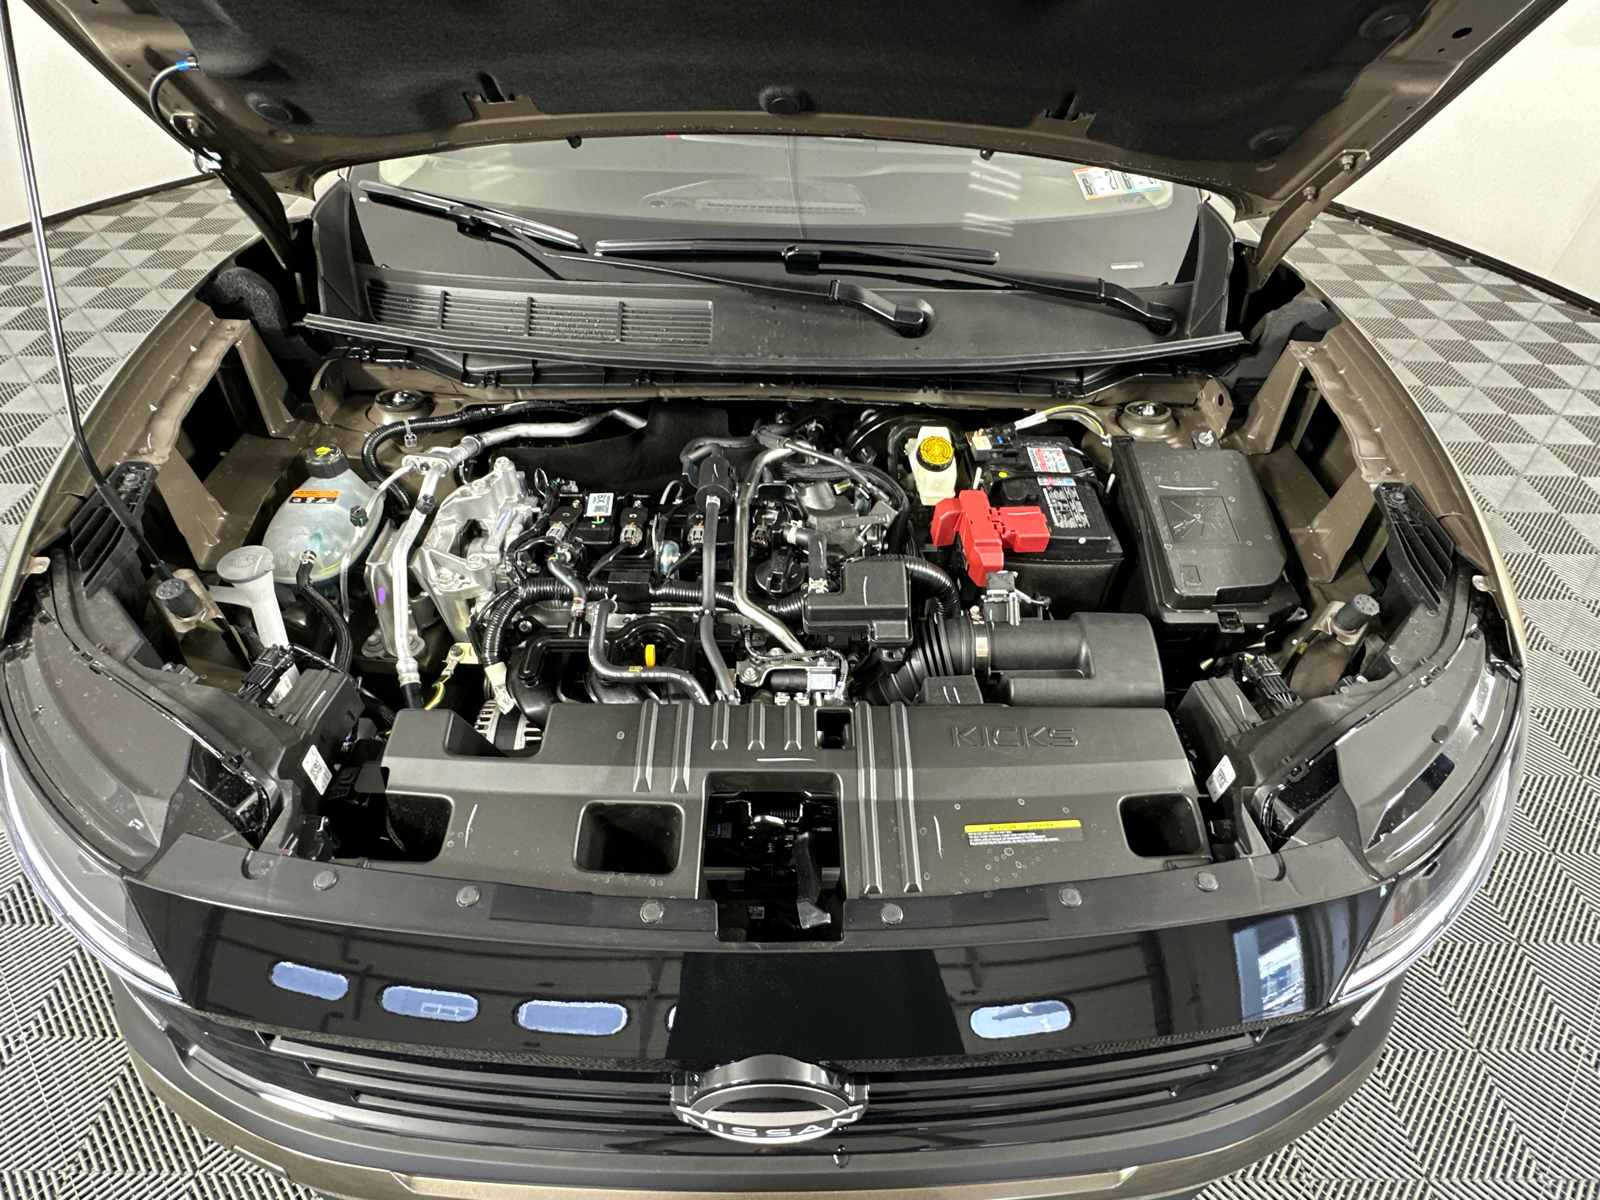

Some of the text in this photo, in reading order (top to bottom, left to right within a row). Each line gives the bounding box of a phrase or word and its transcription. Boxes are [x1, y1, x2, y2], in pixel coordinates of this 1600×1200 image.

[1082, 177, 1094, 196] 6
[950, 726, 1079, 747] KICKS
[682, 1111, 858, 1138] NISSAN
